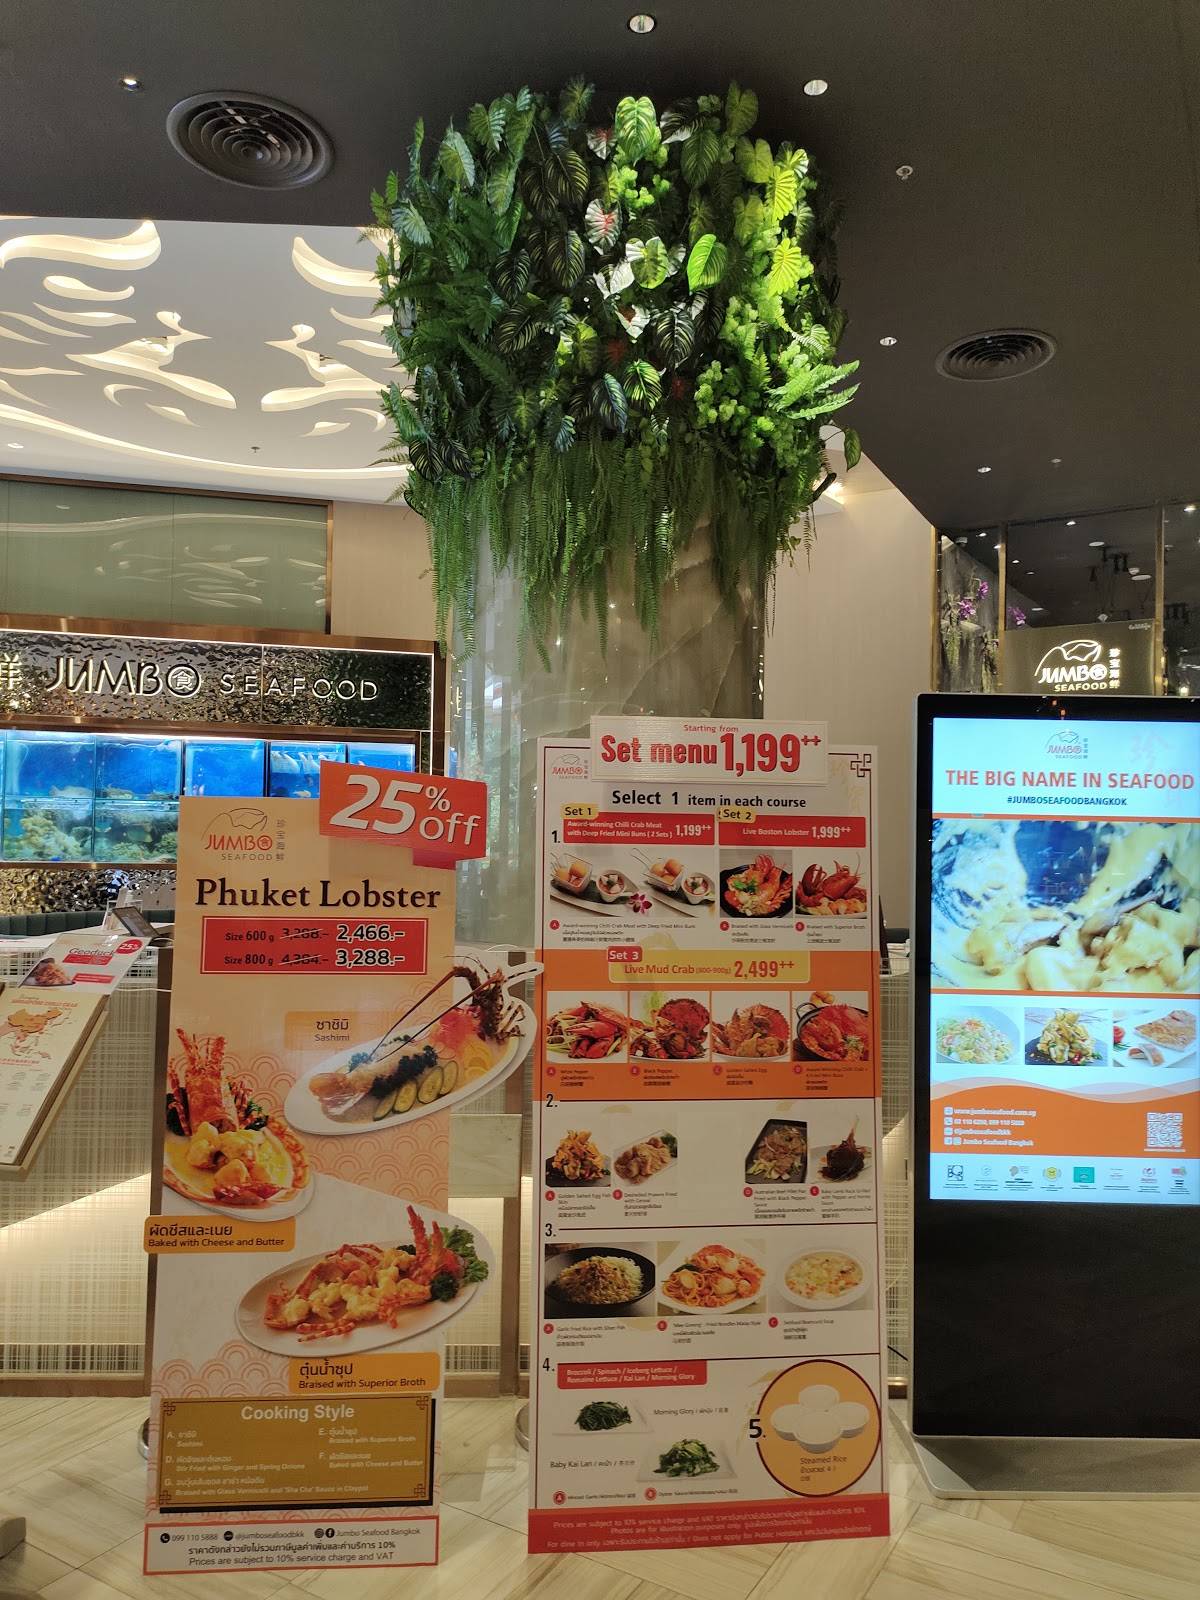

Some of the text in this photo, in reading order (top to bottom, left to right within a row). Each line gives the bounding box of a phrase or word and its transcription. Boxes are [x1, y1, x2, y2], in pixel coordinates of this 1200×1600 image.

[46, 657, 377, 700] JUMBO SEAFOOD
[1038, 664, 1107, 684] JUMBO
[1055, 682, 1107, 692] SEAFOOD
[684, 725, 718, 733] Starting
[602, 735, 641, 762] Set
[651, 744, 717, 764] menu
[946, 770, 1194, 789] THE BIG NAME IN SEAFOOD
[613, 791, 806, 807] Select 1 item in each course
[1007, 796, 1127, 806] #JUMBOSEAFOODBANGKOK
[565, 807, 584, 816] Set
[724, 809, 751, 820] Set 2
[205, 834, 273, 850] JUMBO
[196, 878, 440, 908] Phuket Lobster
[226, 932, 243, 941] Size
[246, 930, 266, 942] 600
[267, 934, 274, 942] g
[225, 956, 242, 965] Size
[245, 955, 265, 966] 800
[267, 958, 273, 966] g
[610, 951, 638, 960] Set 3
[624, 964, 644, 974] Live
[646, 965, 671, 974] Mud
[674, 965, 694, 974] Crab
[202, 1238, 234, 1246] Cheese
[359, 1379, 397, 1388] Superior
[400, 1378, 426, 1386] Broth
[241, 1404, 355, 1423] Cooking Style
[550, 1461, 566, 1469] Baby
[391, 1528, 420, 1536] Bangkok
[190, 1557, 215, 1566] Prices
[234, 1556, 263, 1565] subject
[277, 1554, 294, 1562] 10%
[296, 1554, 326, 1562] service
[328, 1554, 356, 1562] charge
[376, 1552, 394, 1560] VAT
